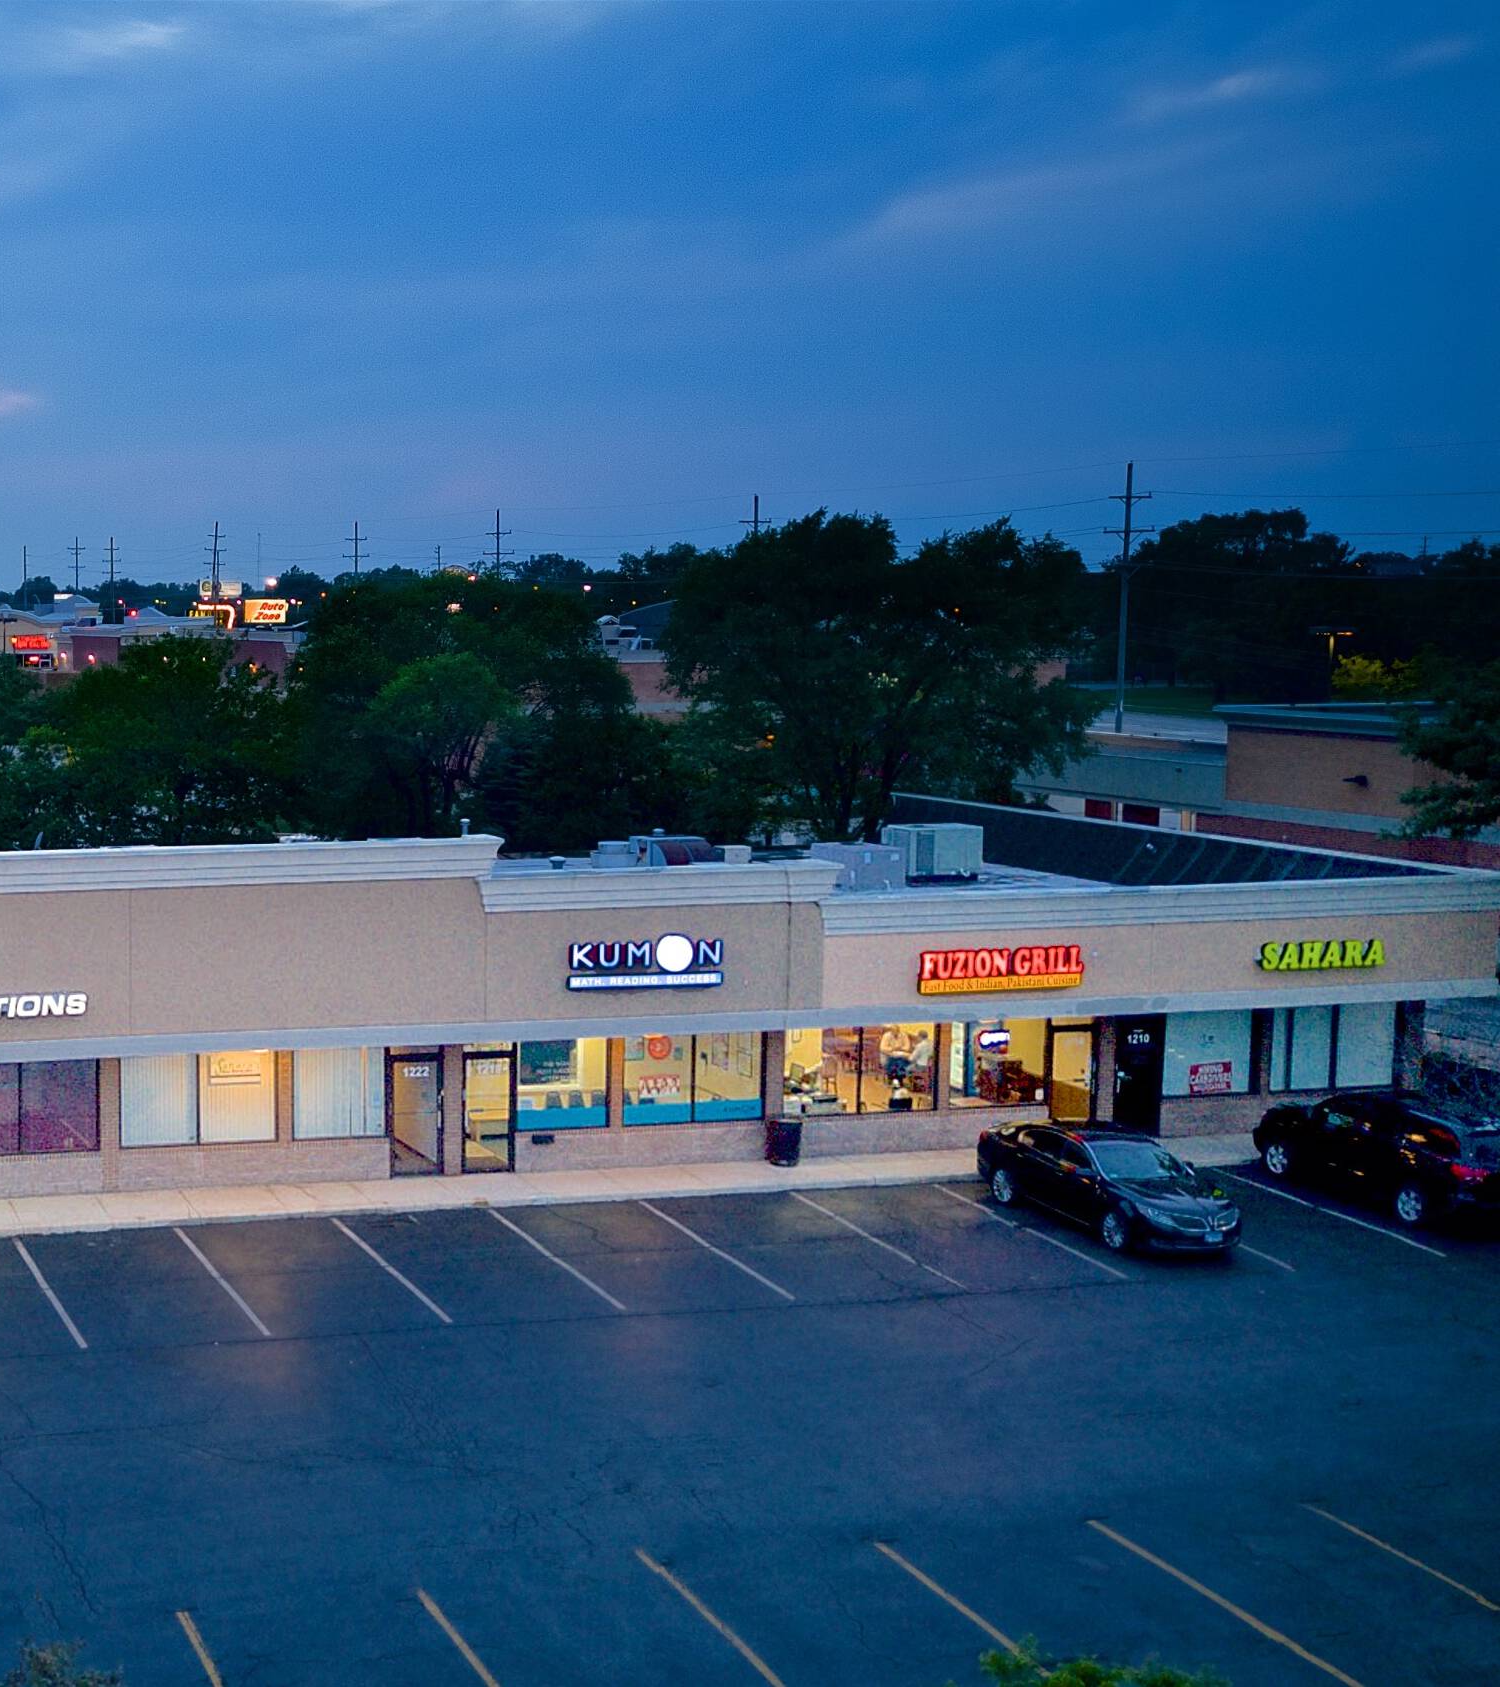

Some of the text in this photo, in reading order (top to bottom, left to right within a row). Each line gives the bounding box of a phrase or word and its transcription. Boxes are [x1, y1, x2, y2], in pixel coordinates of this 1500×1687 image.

[260, 602, 284, 610] Auto
[254, 611, 281, 620] Zone
[571, 934, 722, 974] KUMON
[1261, 939, 1385, 970] SAHARA
[921, 946, 1083, 980] FUZION GRILL
[571, 972, 720, 987] MATH. READING. SUCCESS.
[924, 981, 941, 992] Fast
[943, 980, 965, 991] Food
[966, 979, 973, 989] &
[1007, 976, 1045, 988] Pakistani
[1047, 975, 1078, 986] Cuisine
[1127, 1033, 1151, 1045] 1210
[403, 1065, 430, 1078] 1222
